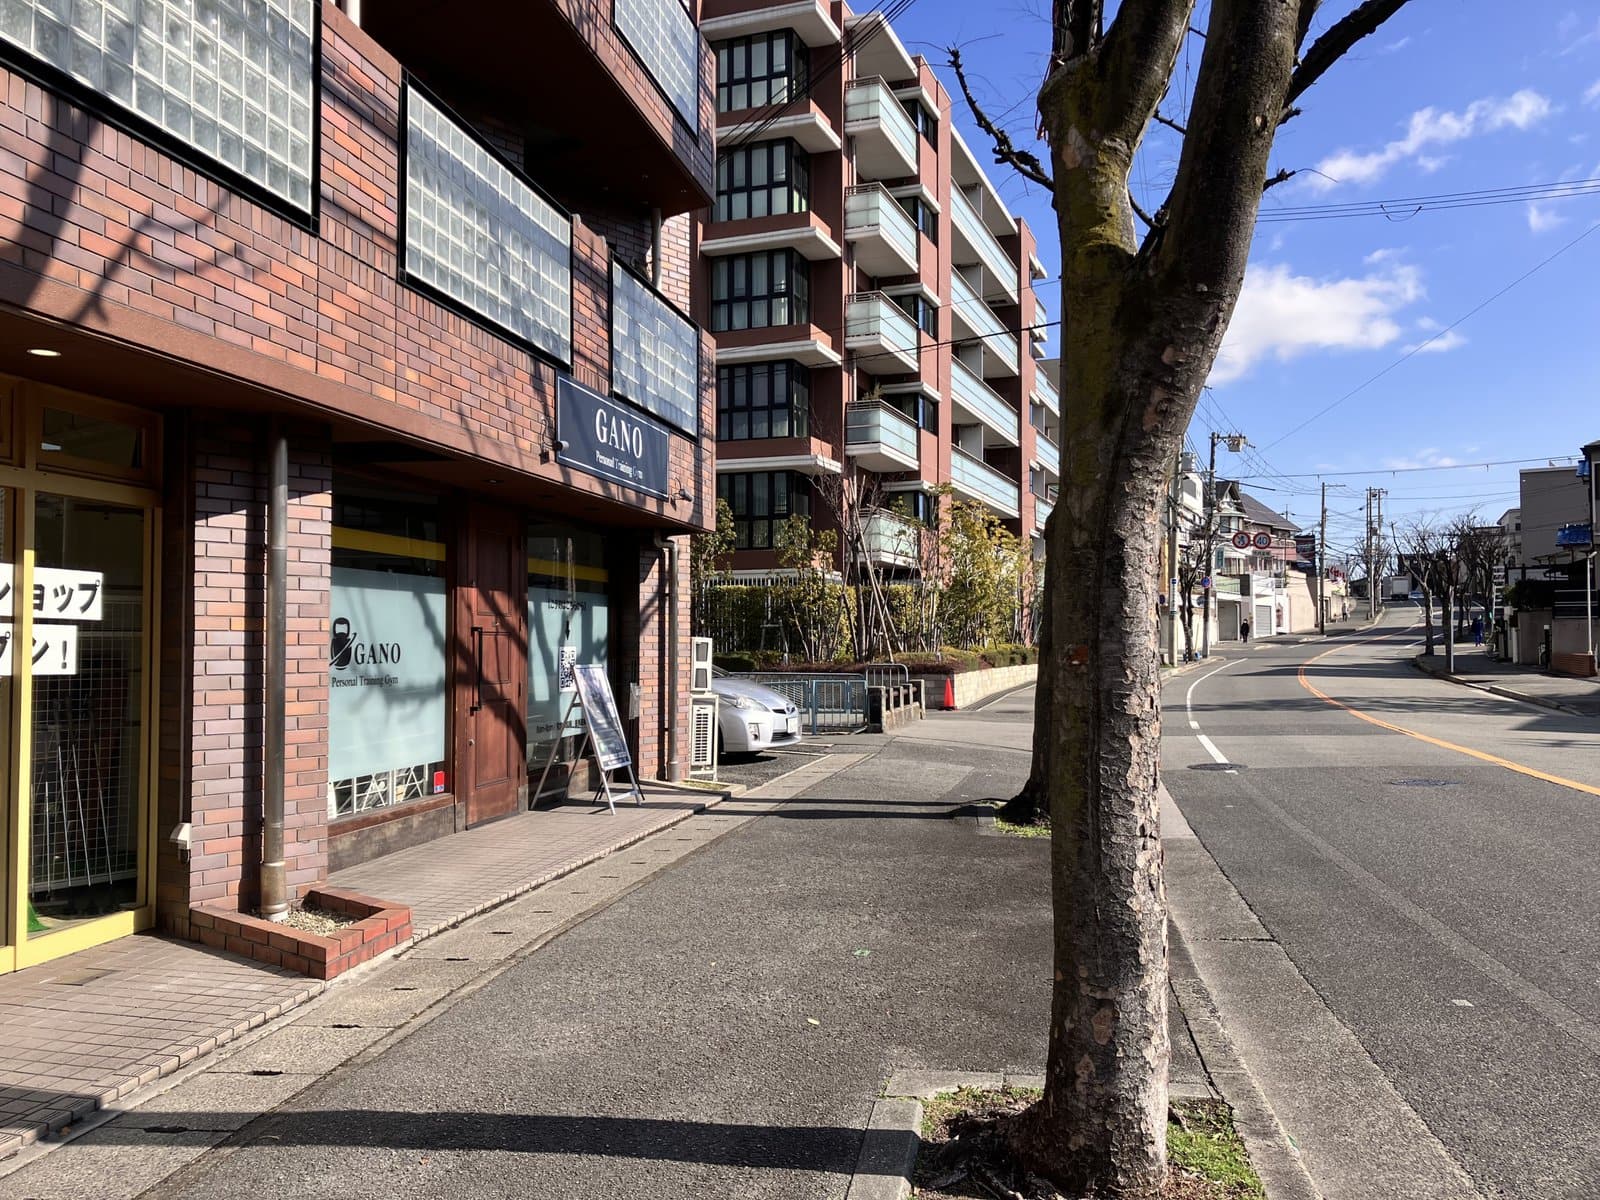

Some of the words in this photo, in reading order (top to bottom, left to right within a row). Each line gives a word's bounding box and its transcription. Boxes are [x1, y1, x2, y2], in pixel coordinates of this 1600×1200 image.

[596, 409, 643, 458] GANO
[1257, 536, 1268, 545] 40
[354, 642, 401, 665] GANO
[331, 676, 358, 688] Personal
[360, 675, 384, 687] Training
[384, 674, 399, 687] Gym
